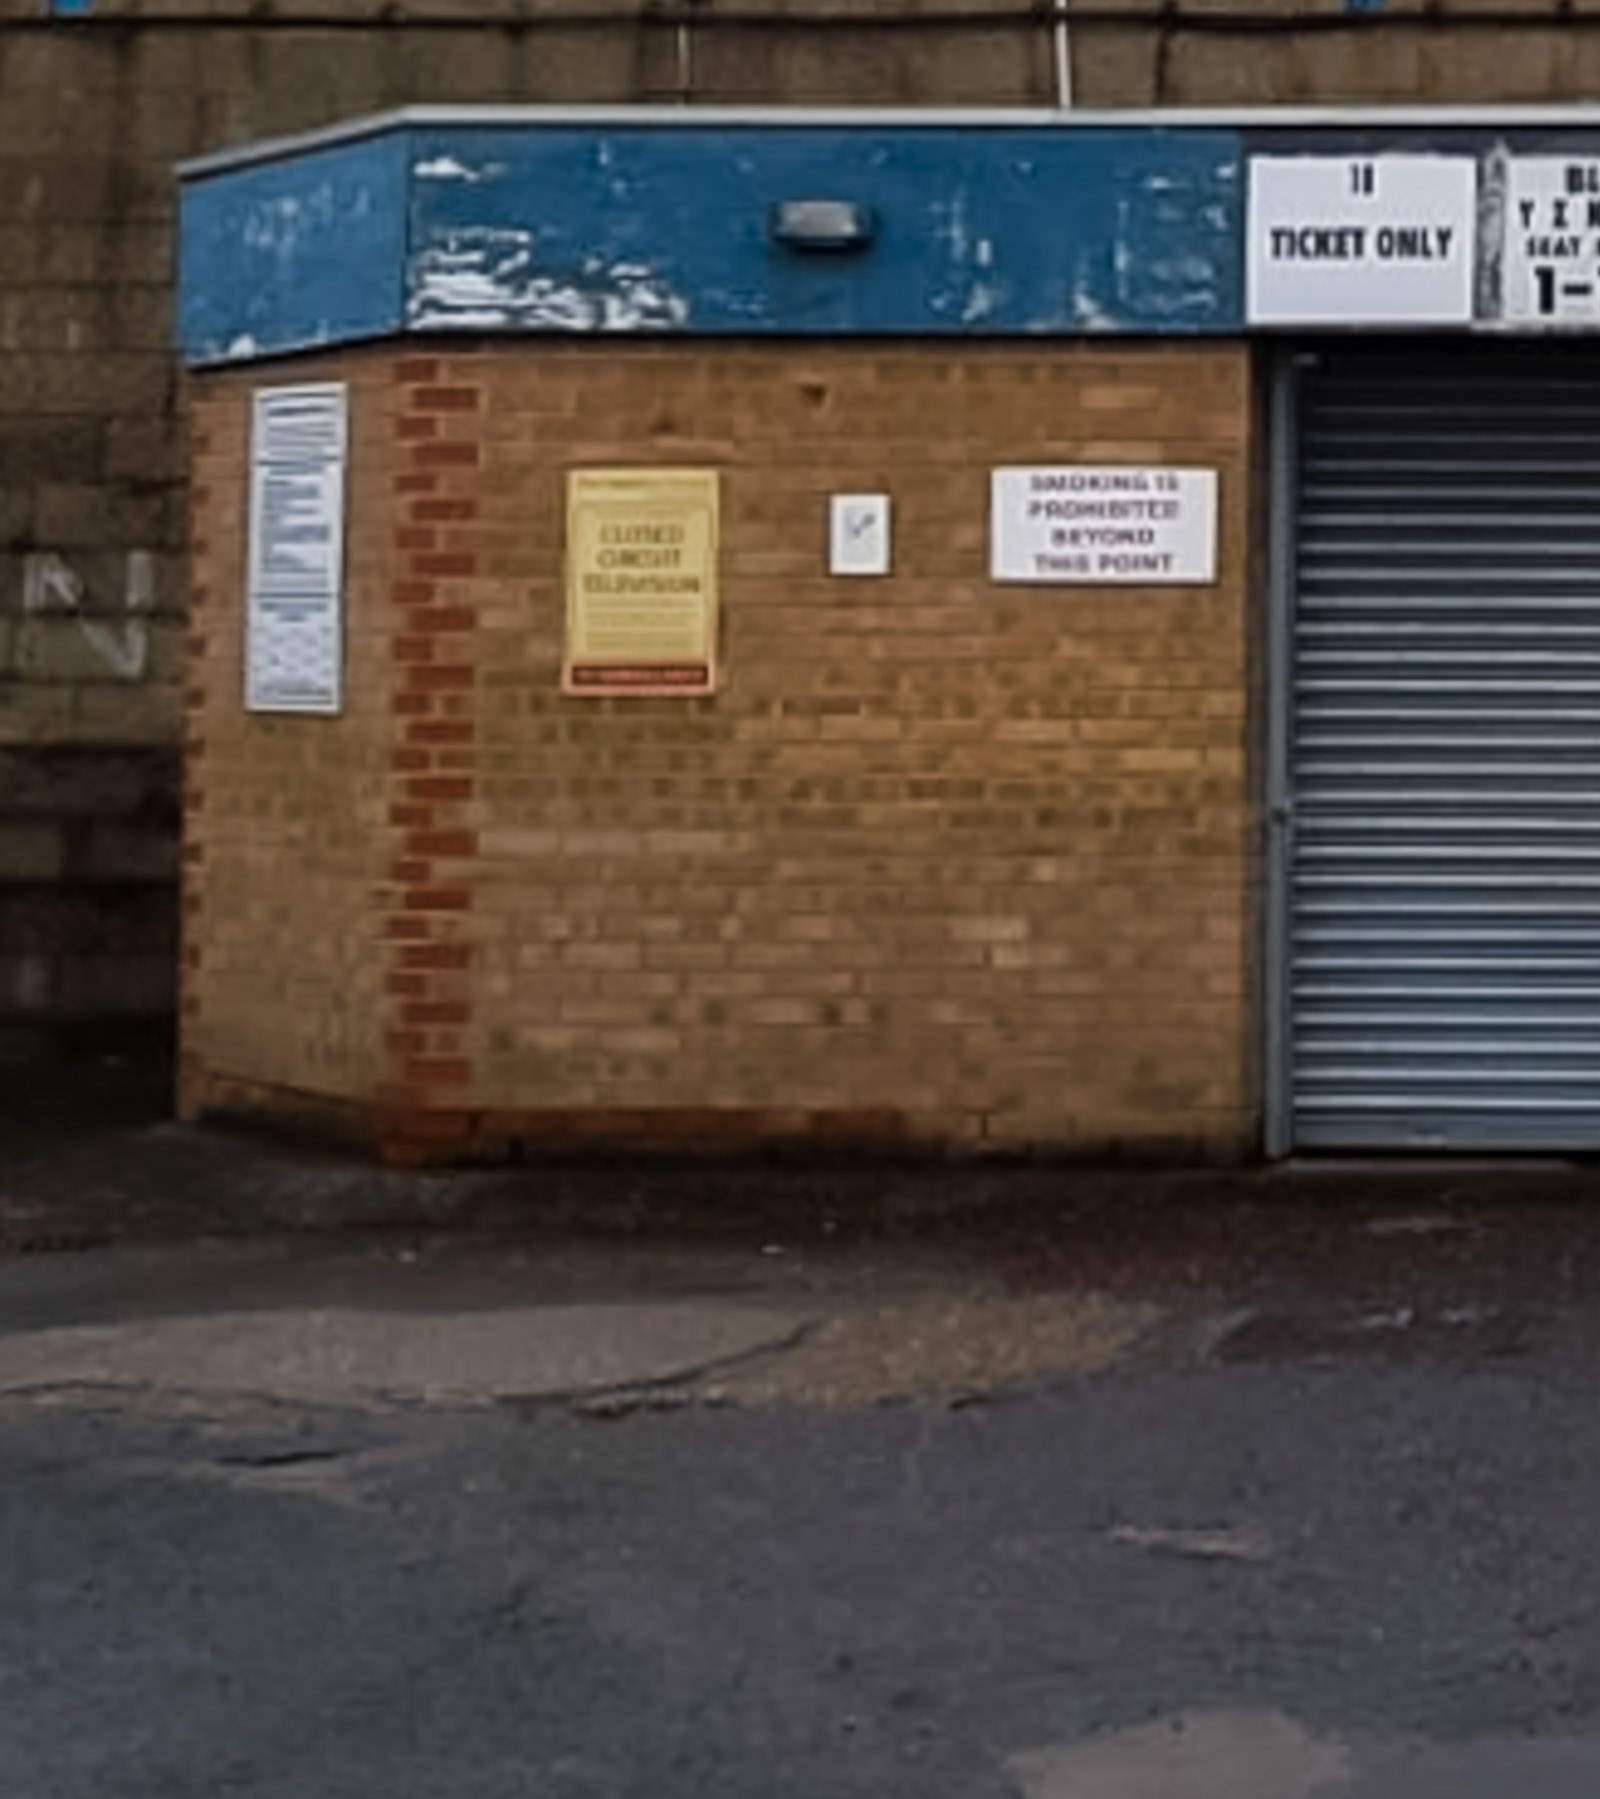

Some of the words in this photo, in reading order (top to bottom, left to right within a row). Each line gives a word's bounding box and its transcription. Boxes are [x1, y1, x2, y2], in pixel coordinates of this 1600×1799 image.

[1518, 199, 1535, 230] Y
[1270, 226, 1366, 260] TICKET
[1376, 226, 1453, 260] ONLY
[1030, 474, 1148, 492] SMOKING
[1051, 528, 1156, 546] BEYOND
[1034, 553, 1090, 572] THIS
[1098, 553, 1173, 572] POINT
